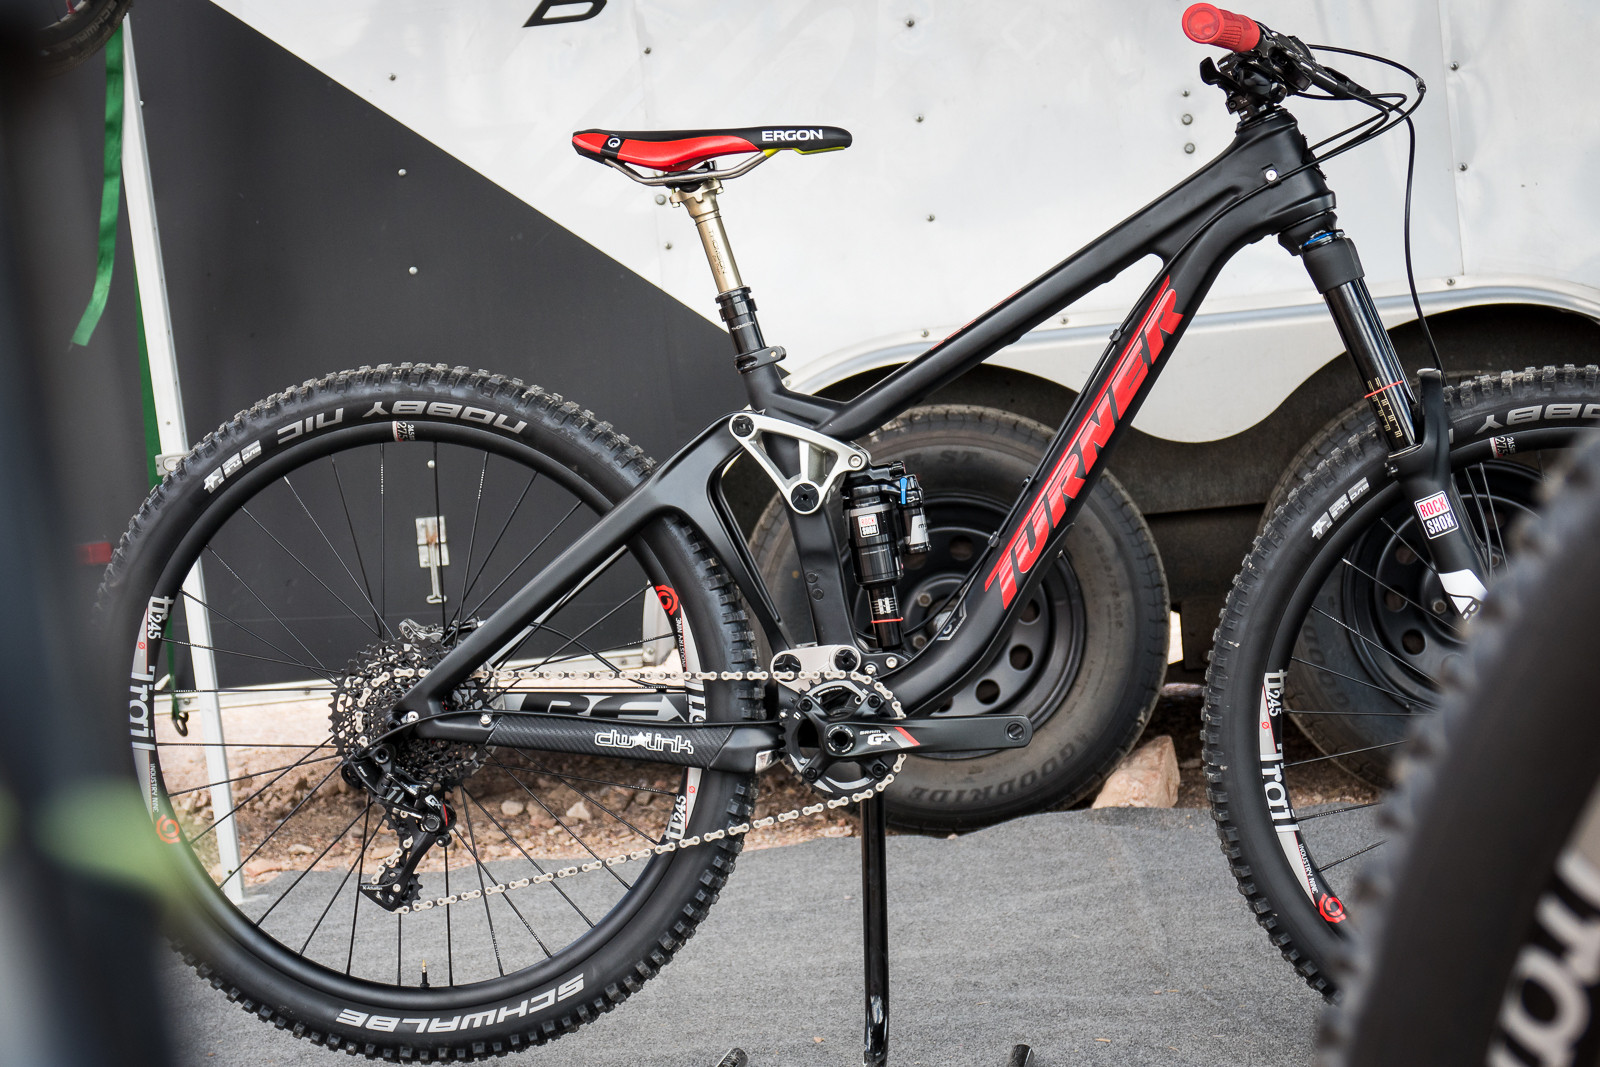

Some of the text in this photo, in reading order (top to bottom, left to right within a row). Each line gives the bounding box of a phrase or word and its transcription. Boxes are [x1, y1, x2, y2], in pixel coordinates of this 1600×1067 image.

[761, 129, 824, 142] ERGON
[276, 400, 528, 445] NOBBY NIC
[985, 274, 1184, 610] TURNER
[1419, 496, 1448, 518] ROCK
[1426, 512, 1455, 535] SHOX
[867, 732, 892, 746] GX
[149, 763, 160, 812] INDUSTRY NINE
[424, 794, 442, 810] GX
[1298, 843, 1319, 895] INDUSTRY NINE
[336, 972, 585, 1034] SCHWALBE
